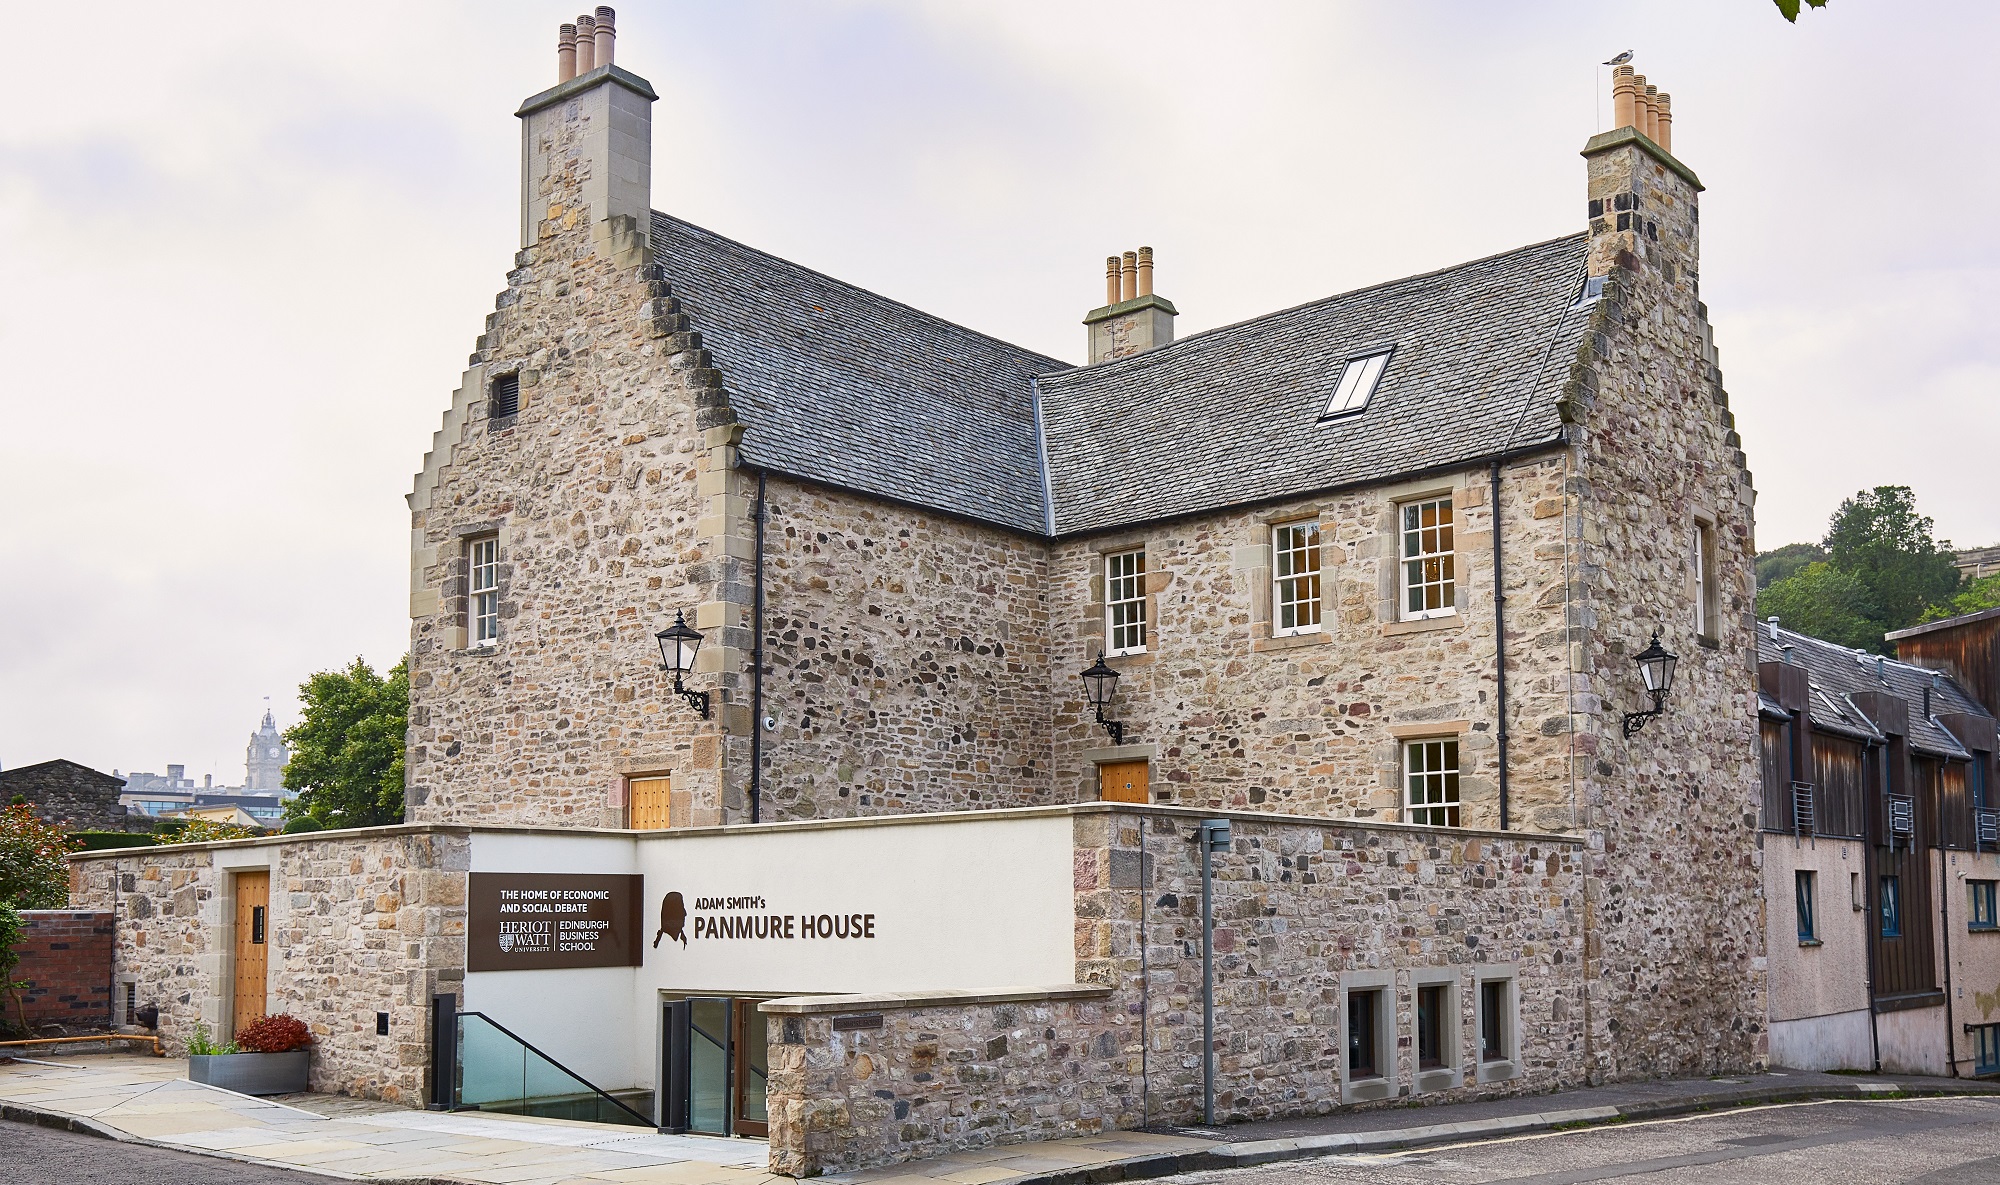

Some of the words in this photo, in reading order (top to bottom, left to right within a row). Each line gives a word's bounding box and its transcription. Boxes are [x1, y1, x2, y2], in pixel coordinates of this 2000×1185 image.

[500, 890, 519, 900] THE
[520, 890, 548, 900] HOME
[549, 890, 562, 900] OF
[563, 890, 610, 900] ECONOMIC
[695, 897, 725, 910] ADAM
[726, 895, 766, 910] SMITH's
[500, 903, 521, 913] AND
[522, 903, 553, 913] SOCIAL
[555, 903, 588, 913] DEBATE
[499, 920, 552, 934] HERIOT
[559, 920, 609, 930] EDINBURGH
[694, 915, 795, 939] PANMURE
[801, 913, 876, 939] HOUSE
[514, 933, 552, 946] WATT
[559, 931, 599, 941] BUSINESS
[559, 942, 596, 952] SCHOOL
